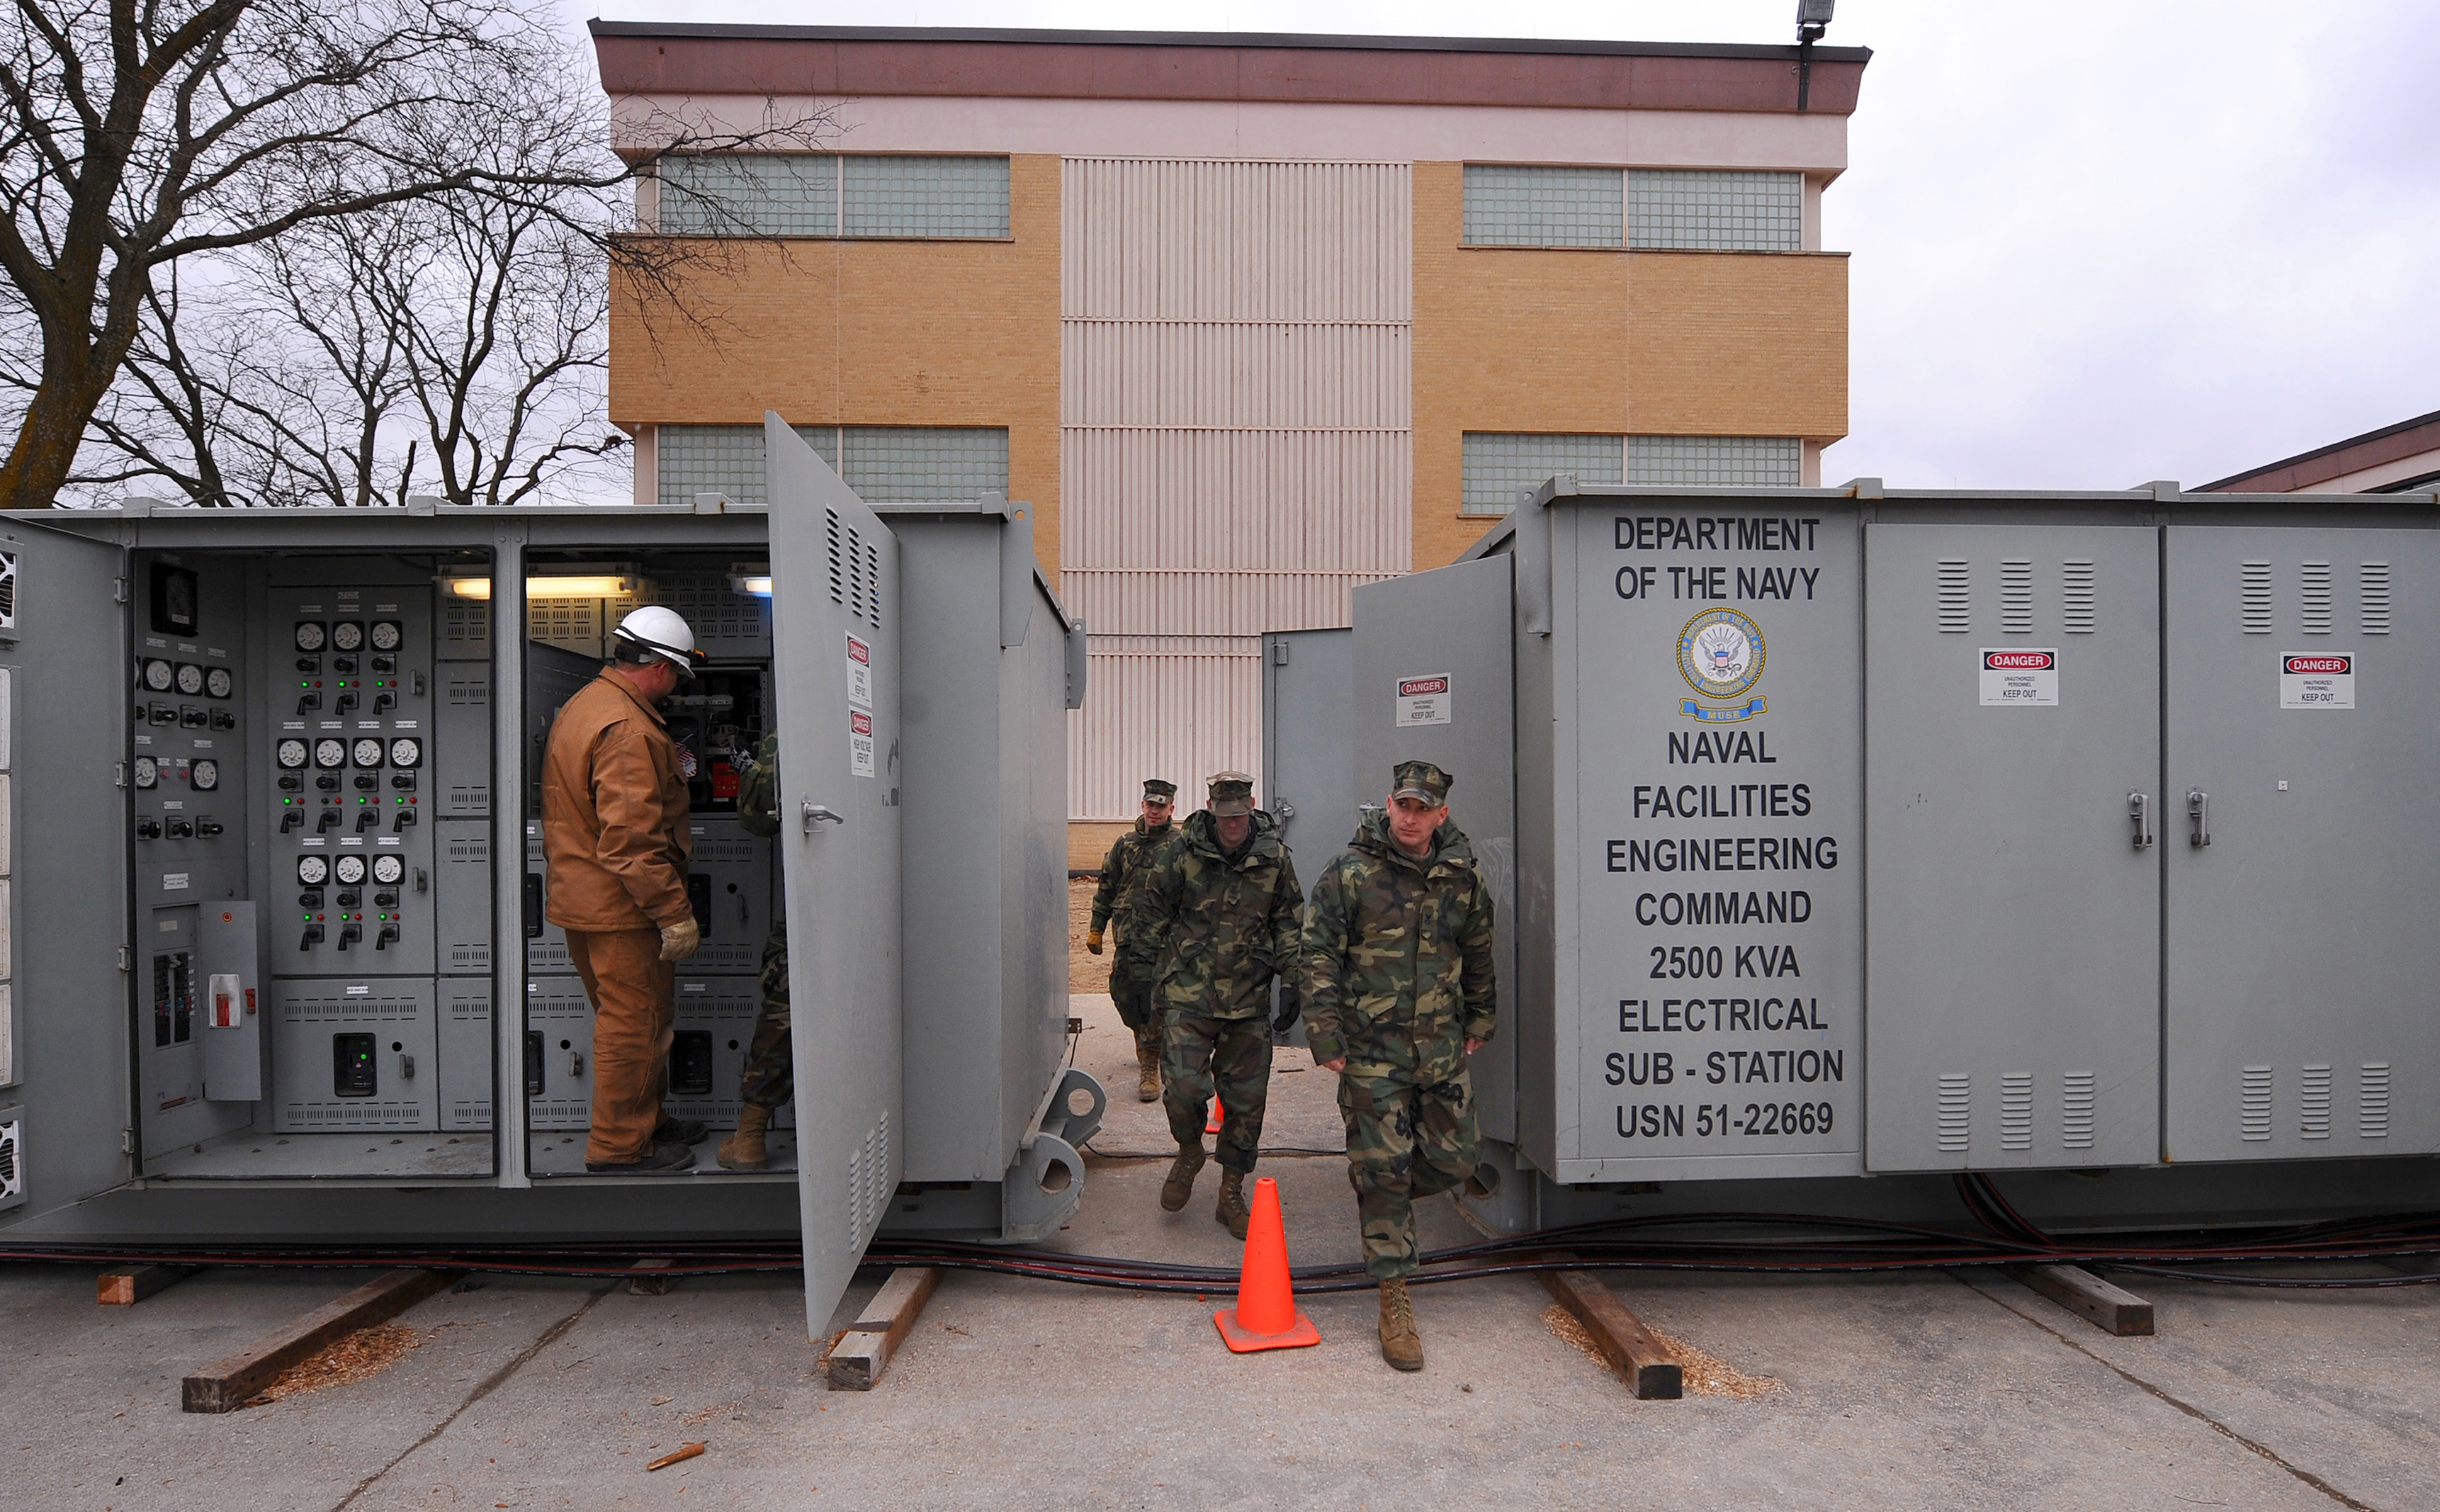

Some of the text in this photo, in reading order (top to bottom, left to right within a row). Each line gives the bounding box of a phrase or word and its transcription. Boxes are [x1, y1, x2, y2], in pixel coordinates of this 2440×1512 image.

[1614, 517, 1820, 551] DEPARTMENT
[1615, 566, 1820, 600] OF THE NAVY
[850, 642, 867, 661] DANGER
[1994, 655, 2044, 666] DANGER
[2293, 660, 2341, 670] DANGER
[1406, 682, 1441, 693] DANGER
[2003, 689, 2038, 698] KEEP OUT
[853, 716, 869, 731] DANGER
[1707, 711, 1741, 719] MUSE
[1668, 731, 1777, 764] NAVAL
[1633, 784, 1811, 818] FACILITIES
[1607, 837, 1838, 873] ENGINEERING
[1634, 891, 1812, 926] COMMAND
[1649, 945, 1801, 979] 2500 KVA
[1619, 998, 1828, 1032] ELECTRICAL
[1605, 1052, 1674, 1085] SUB
[1706, 1049, 1843, 1084] STATION
[1616, 1102, 1833, 1138] USN 51-22669
